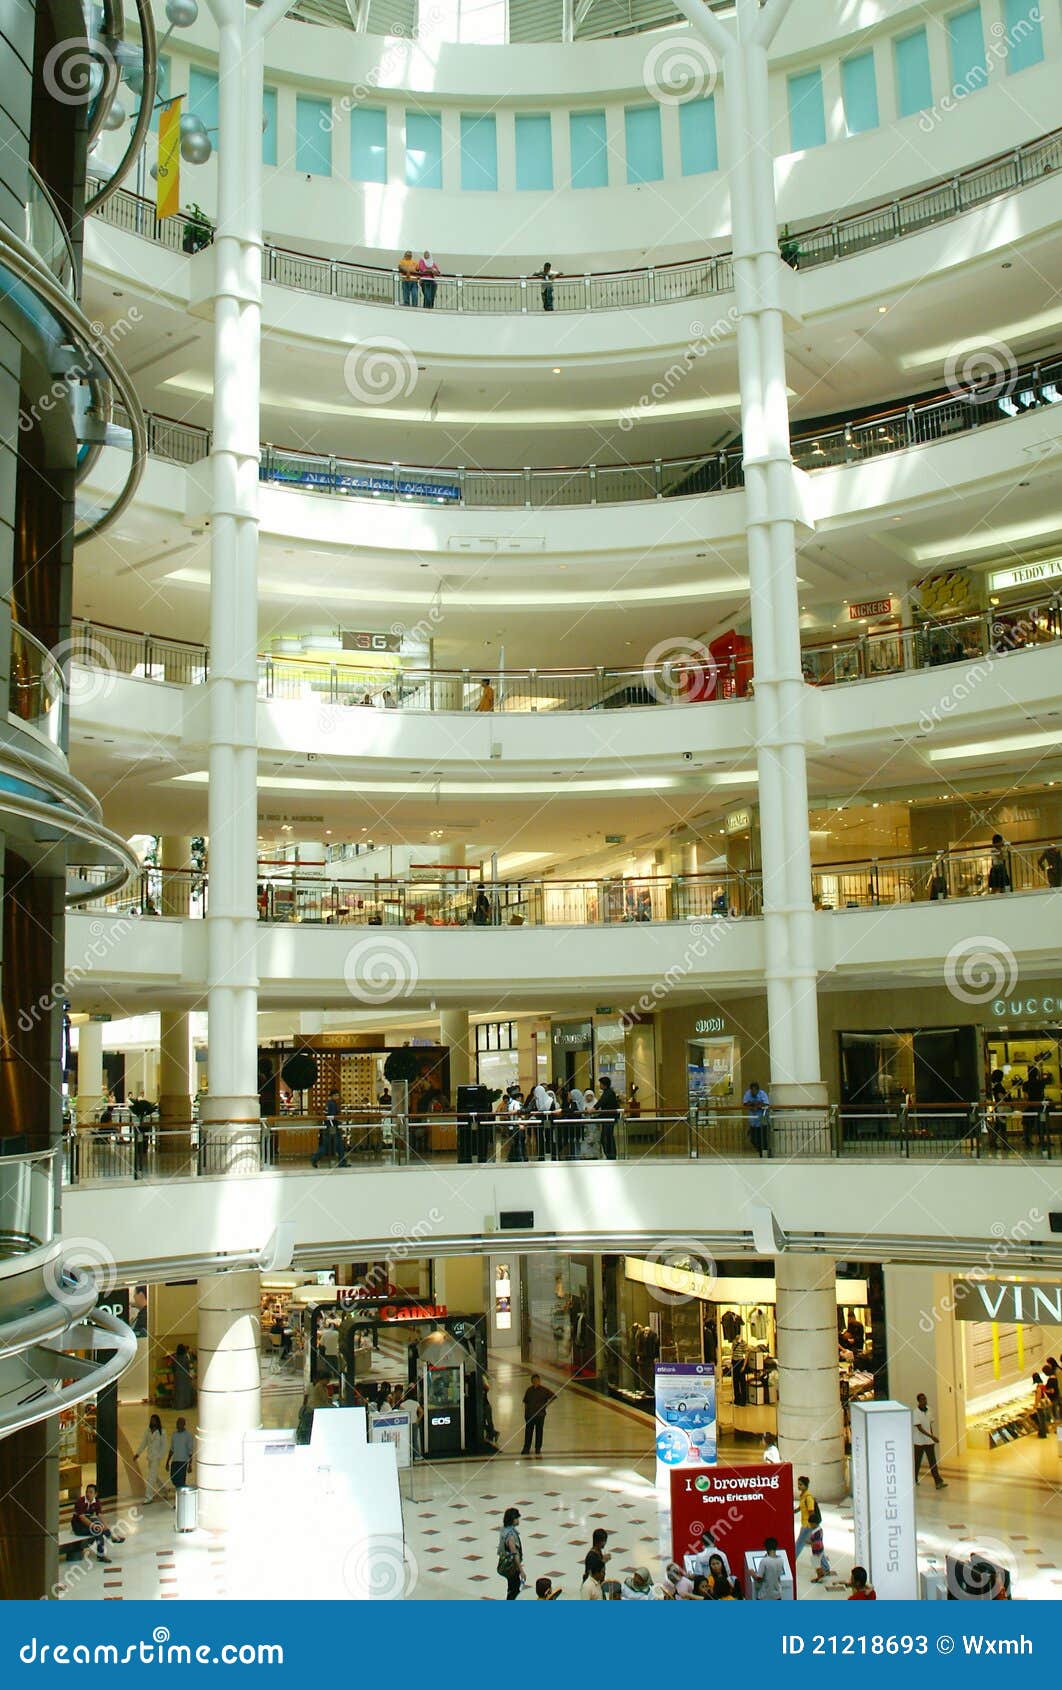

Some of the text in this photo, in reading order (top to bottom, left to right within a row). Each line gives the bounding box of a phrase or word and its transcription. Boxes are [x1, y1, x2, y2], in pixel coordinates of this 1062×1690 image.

[1011, 565, 1045, 583] TEDDY
[851, 600, 890, 618] KICKERS
[356, 635, 387, 649] 3G
[977, 1285, 1062, 1322] VIN
[431, 1417, 451, 1426] EOS
[685, 1475, 779, 1492] I browsing
[702, 1493, 764, 1503] Sony Ericsson
[884, 1439, 901, 1573] Sony Ericsson
